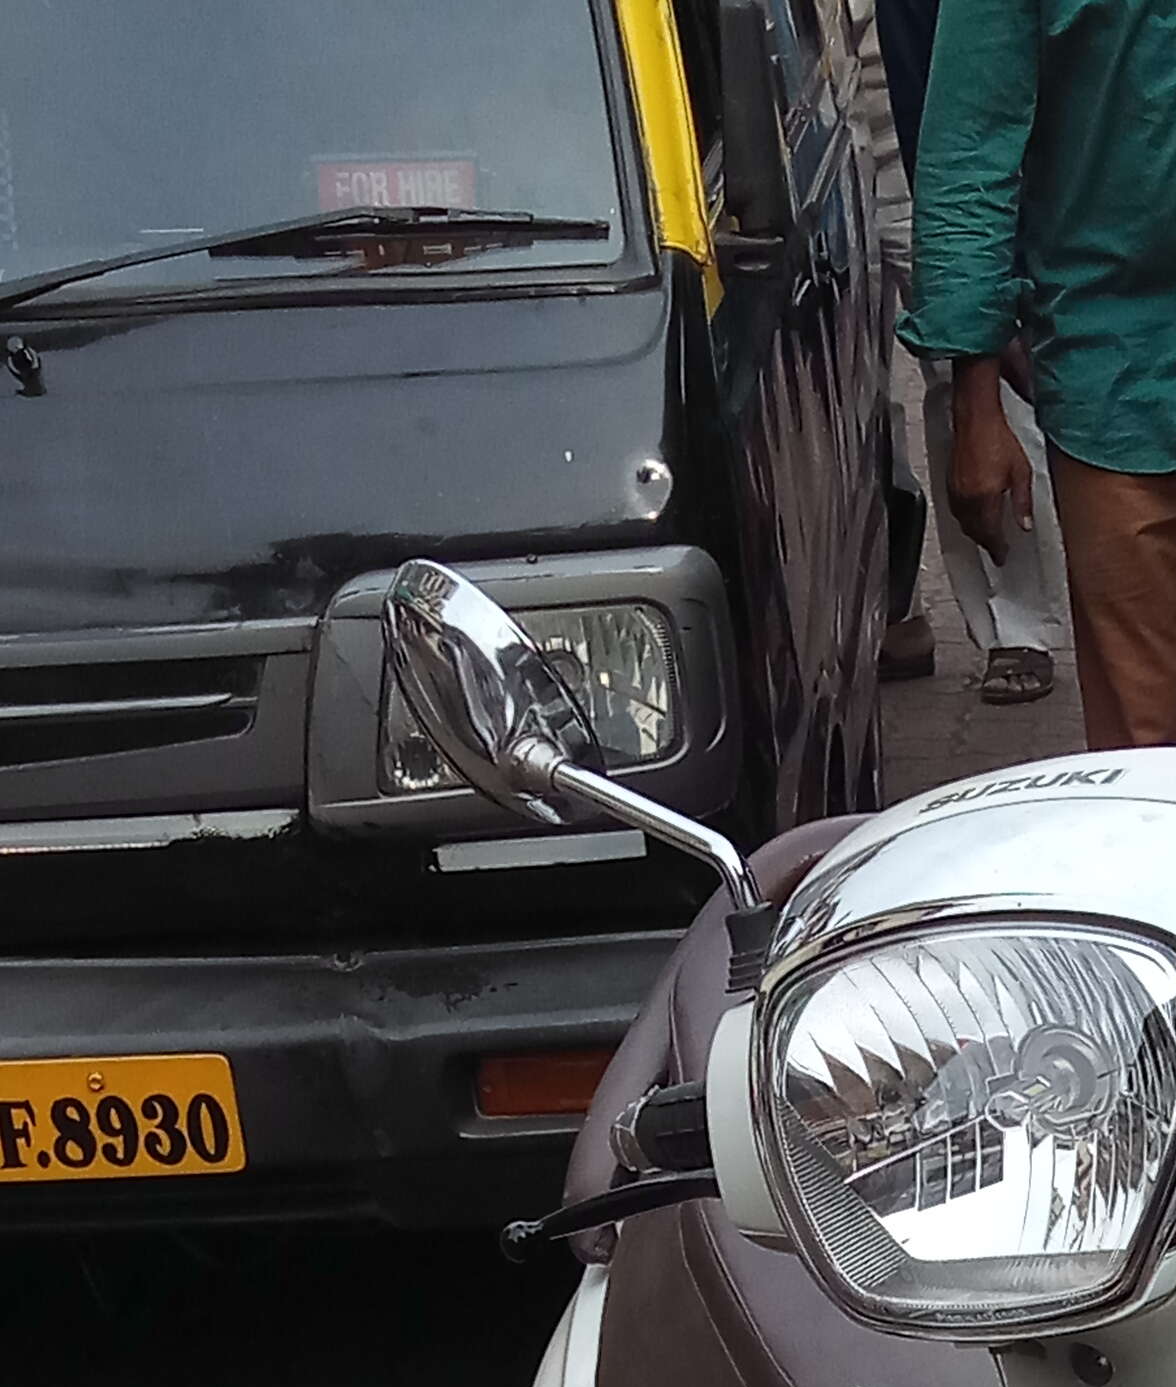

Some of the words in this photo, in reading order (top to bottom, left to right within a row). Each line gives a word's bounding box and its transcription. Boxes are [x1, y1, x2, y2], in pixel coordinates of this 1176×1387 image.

[335, 170, 391, 208] FOR
[397, 168, 459, 207] HIRE
[918, 768, 1128, 814] SUZUKI
